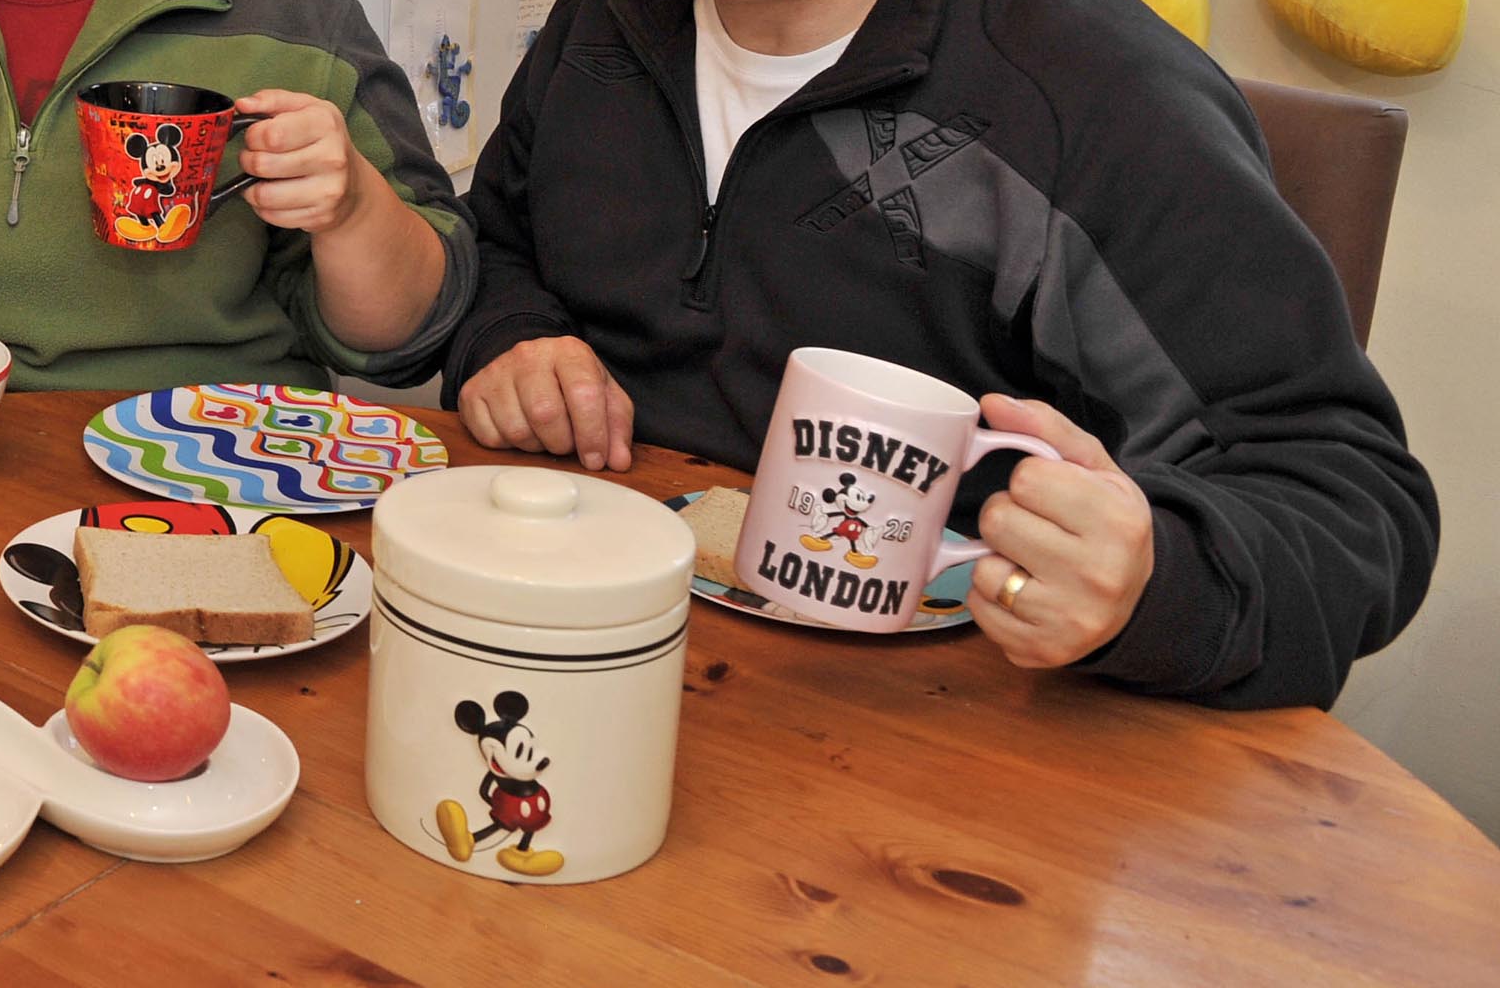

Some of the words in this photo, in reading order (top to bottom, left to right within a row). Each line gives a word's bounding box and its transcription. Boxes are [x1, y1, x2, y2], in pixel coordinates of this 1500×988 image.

[187, 119, 214, 181] Mickey
[793, 418, 950, 494] DISNEY
[787, 486, 815, 516] 19
[757, 540, 909, 615] LONDON
